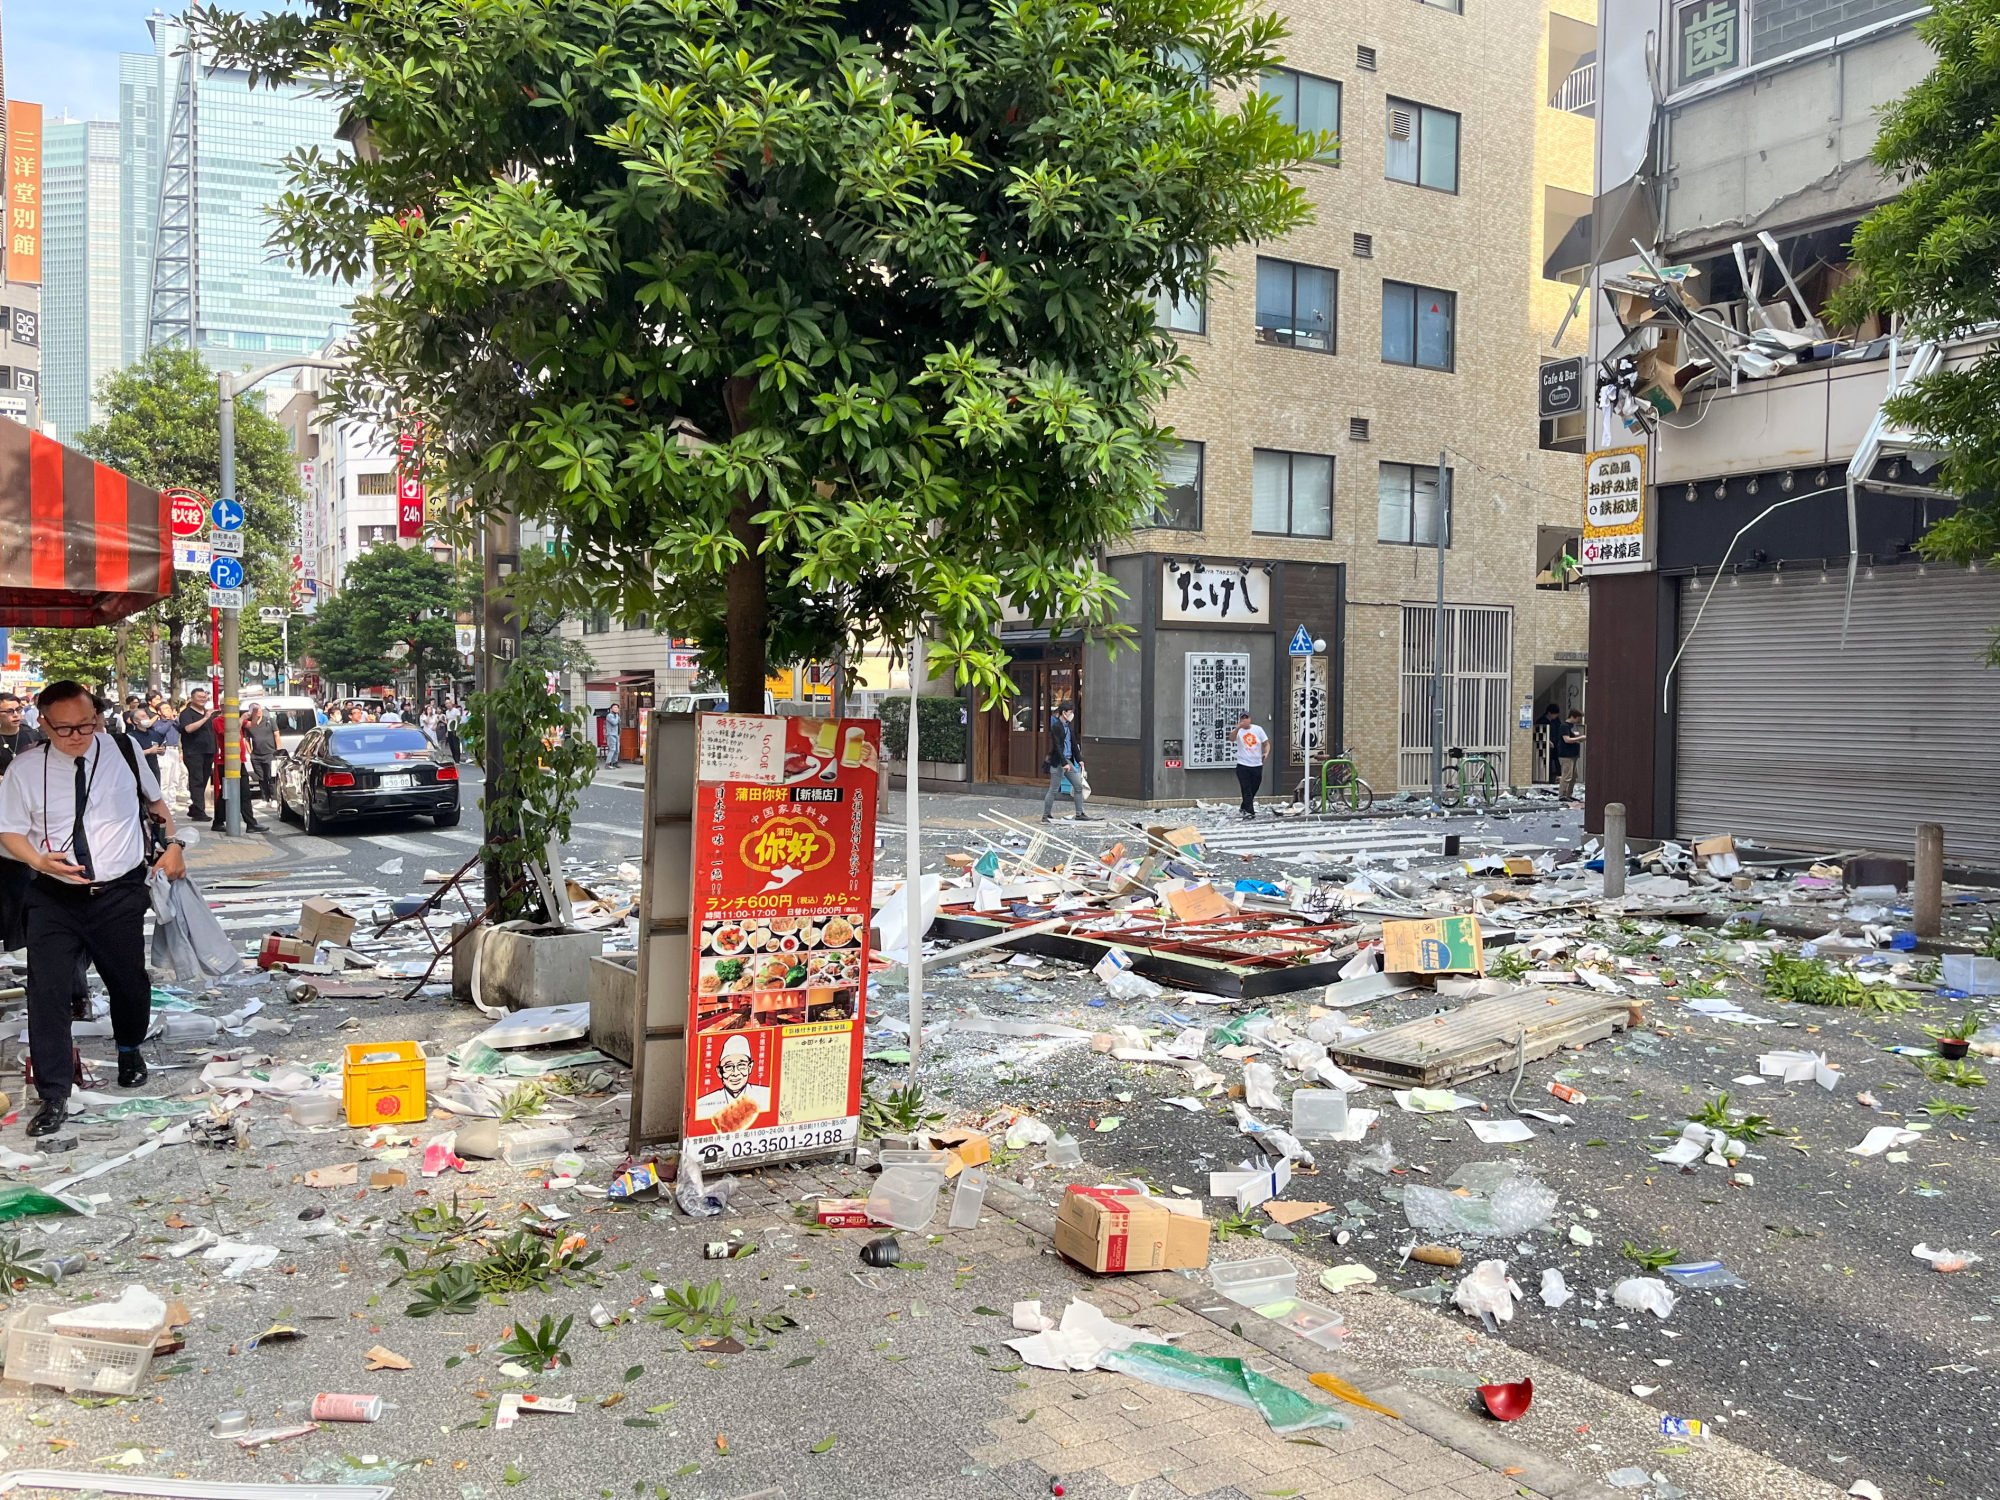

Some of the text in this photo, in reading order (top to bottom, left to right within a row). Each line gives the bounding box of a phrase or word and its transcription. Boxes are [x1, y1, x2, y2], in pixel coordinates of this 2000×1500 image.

[1685, 1, 1736, 78] 歯
[13, 131, 36, 257] 三洋堂別館
[1544, 373, 1558, 386] Cafe
[1564, 370, 1576, 381] Bar
[1599, 460, 1631, 476] 広島風
[1589, 476, 1638, 495] お好み焼
[403, 505, 420, 522] 24h
[1600, 498, 1638, 516] 鉄板焼
[213, 541, 240, 549] 一方通行
[1588, 549, 1598, 557] B1
[1600, 541, 1641, 560] 檸檬屋
[217, 566, 230, 585] P
[226, 577, 236, 586] 60
[1177, 571, 1259, 618] たけし
[760, 734, 773, 770] 500円
[735, 787, 789, 801] 蒲田你好
[751, 804, 829, 827] 中国家庭料理
[776, 828, 793, 836] 蒲田
[754, 831, 819, 865] 你好
[706, 894, 793, 911] ランチ600円
[705, 909, 777, 920] 時間11:00-17:00
[787, 907, 841, 916] 日替わり600円
[732, 1129, 842, 1158] 03-3501-2188
[1115, 1237, 1123, 1268] MADISON
